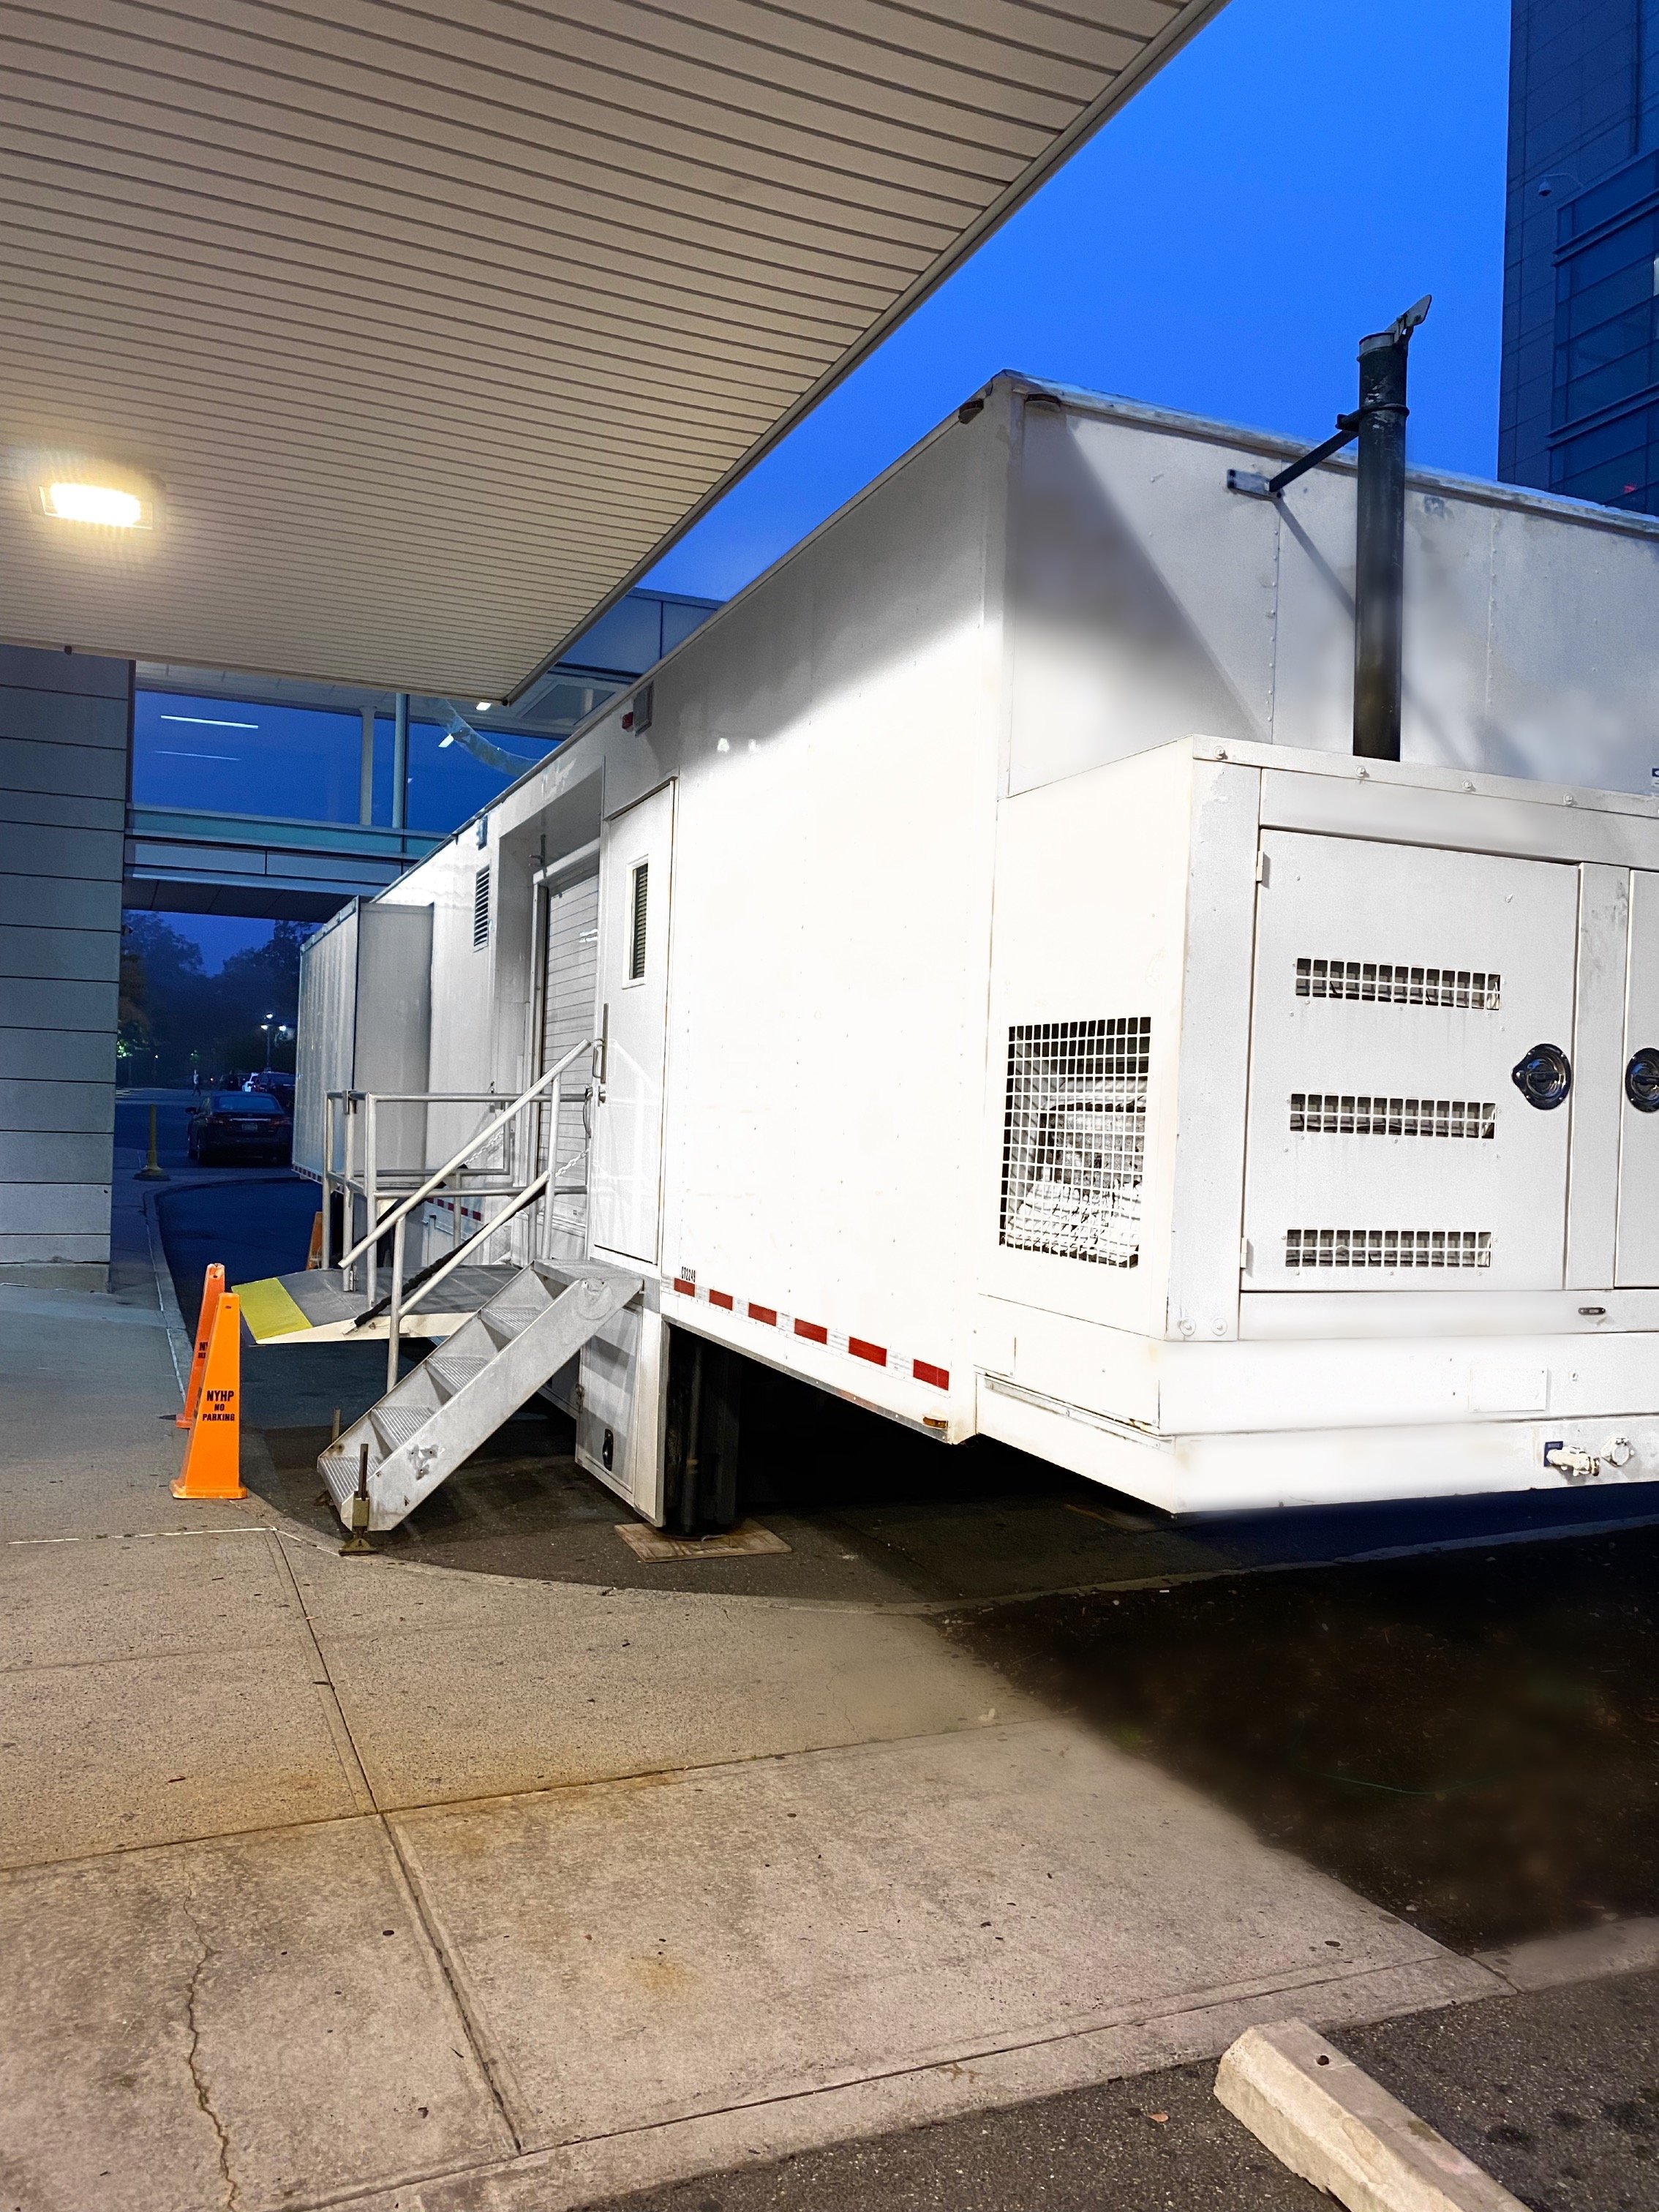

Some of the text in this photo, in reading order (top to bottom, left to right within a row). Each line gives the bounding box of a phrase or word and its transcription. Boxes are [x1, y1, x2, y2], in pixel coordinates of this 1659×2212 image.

[206, 1390, 234, 1402] NYHP
[214, 1403, 225, 1411] NO
[202, 1413, 235, 1421] PARKING
